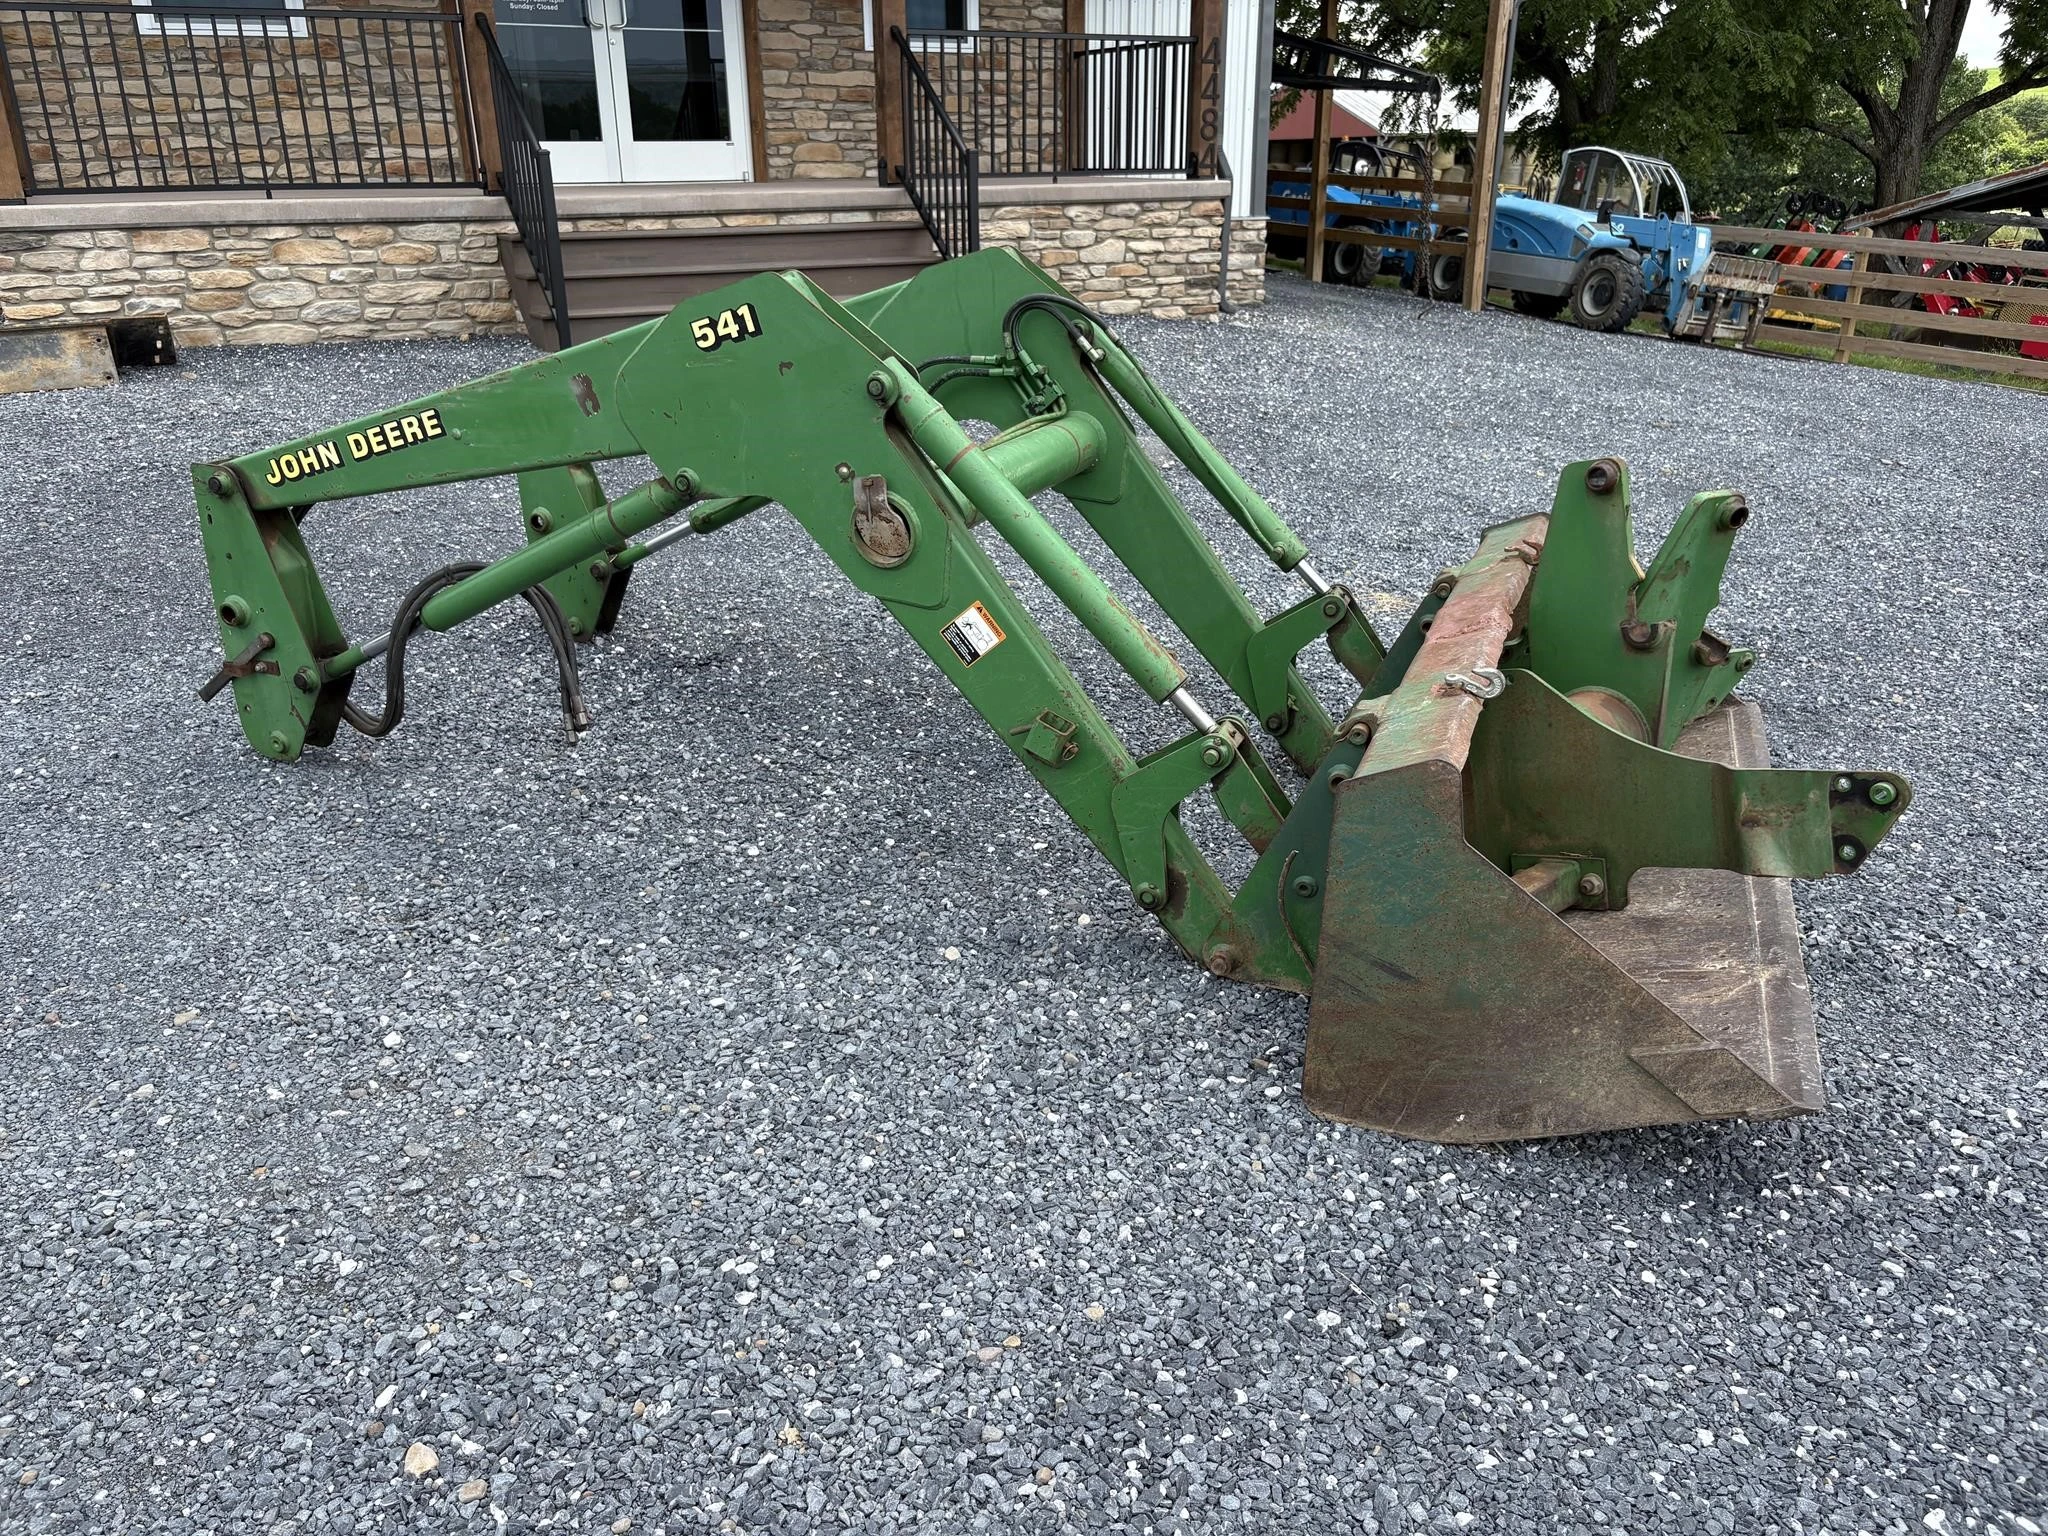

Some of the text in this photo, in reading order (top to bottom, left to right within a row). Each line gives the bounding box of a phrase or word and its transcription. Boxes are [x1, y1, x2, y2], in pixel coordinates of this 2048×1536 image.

[510, 2, 535, 10] Sunday:
[1199, 37, 1220, 176] 4484
[690, 303, 759, 350] 541
[265, 408, 444, 486] JOHN DEERE
[982, 612, 1003, 638] WARNING
